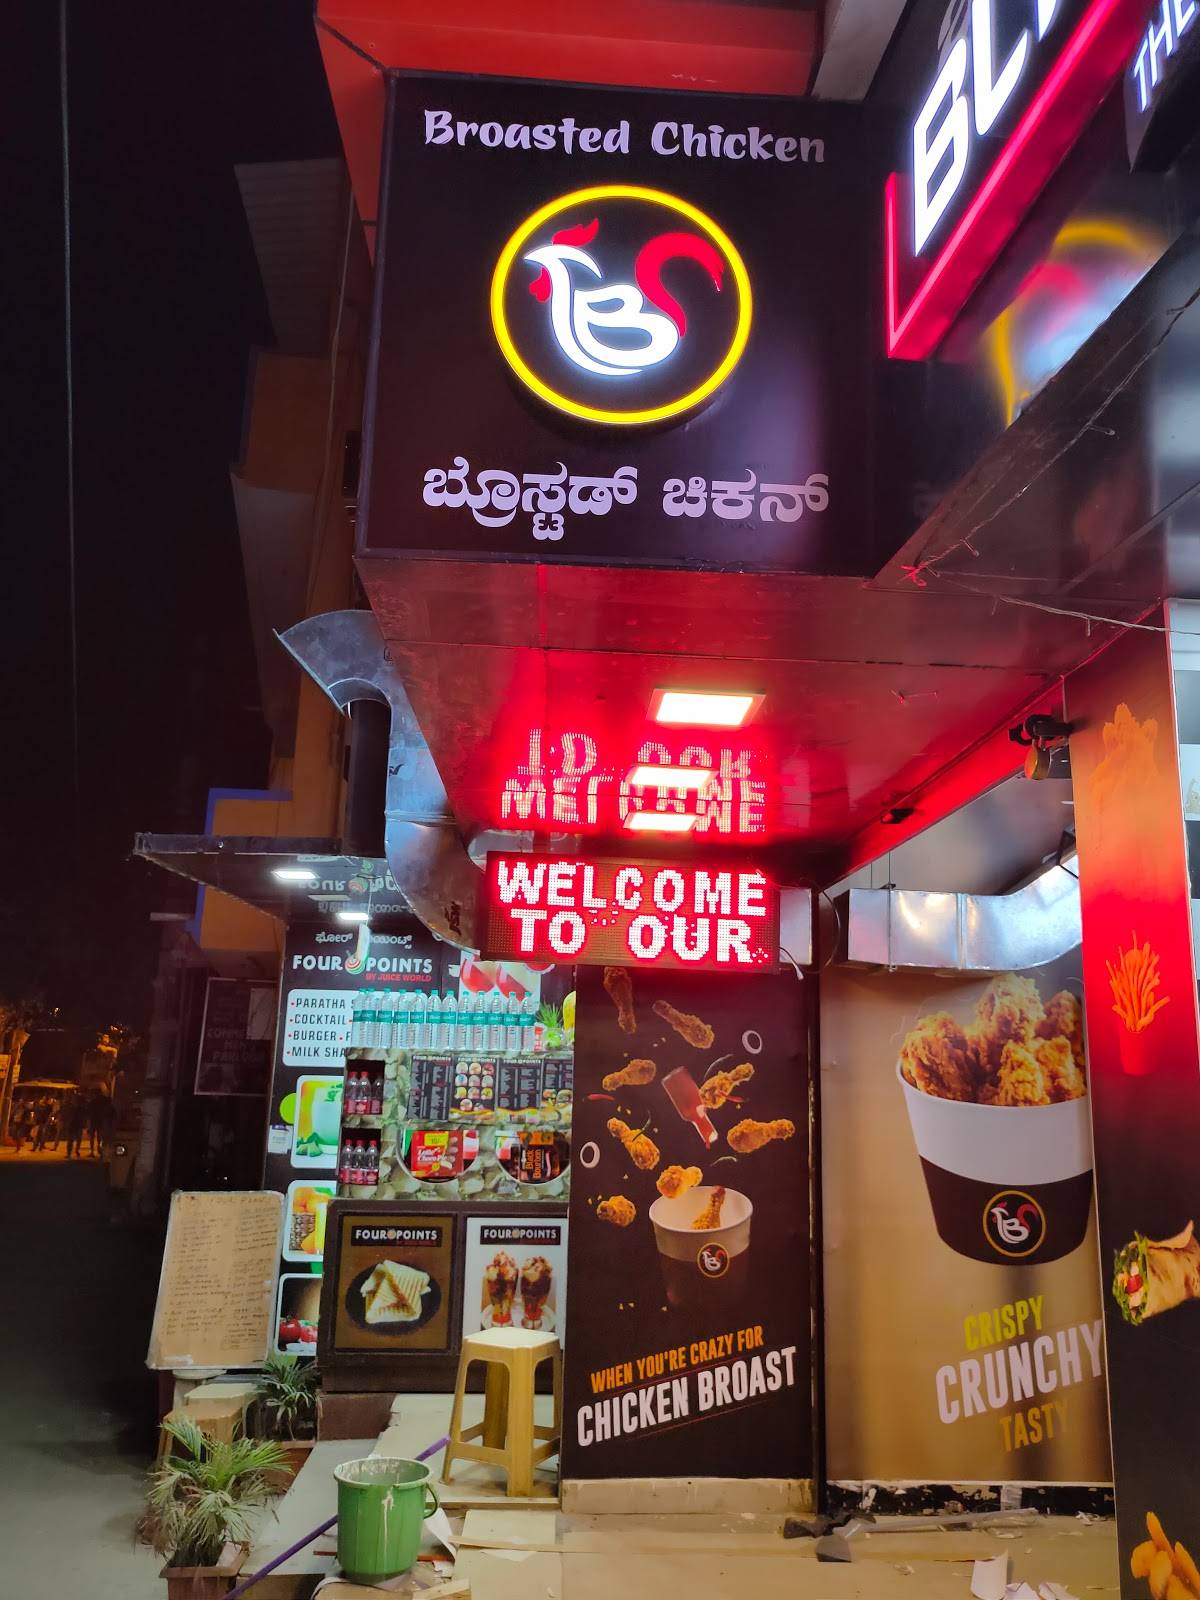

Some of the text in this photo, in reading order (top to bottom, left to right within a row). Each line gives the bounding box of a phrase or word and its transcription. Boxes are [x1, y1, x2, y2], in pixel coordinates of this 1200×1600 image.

[424, 109, 825, 163] Broasted Chicken
[914, 0, 1057, 257] BL
[662, 468, 829, 523] ಚಿಕನ್
[498, 861, 766, 916] WELCOME
[511, 909, 752, 962] TO OUR
[292, 955, 433, 974] FOUR POINTS
[378, 973, 401, 981] JUICE
[402, 974, 432, 982] WORLD
[294, 1014, 346, 1025] COCKTAIL
[296, 998, 345, 1009] PARATHA
[291, 1046, 320, 1057] MILK
[293, 1030, 337, 1041] BURGER
[355, 1229, 437, 1240] FOUR POINTS
[484, 1228, 556, 1239] FOUR POINTS
[963, 1295, 1044, 1350] CRISPY
[590, 1325, 764, 1393] WHEN YOU'RE CRAZY FOR
[935, 1319, 1104, 1424] CRUNCHY
[577, 1346, 796, 1447] CHICKEN BROAST
[1000, 1400, 1070, 1452] TASTY
